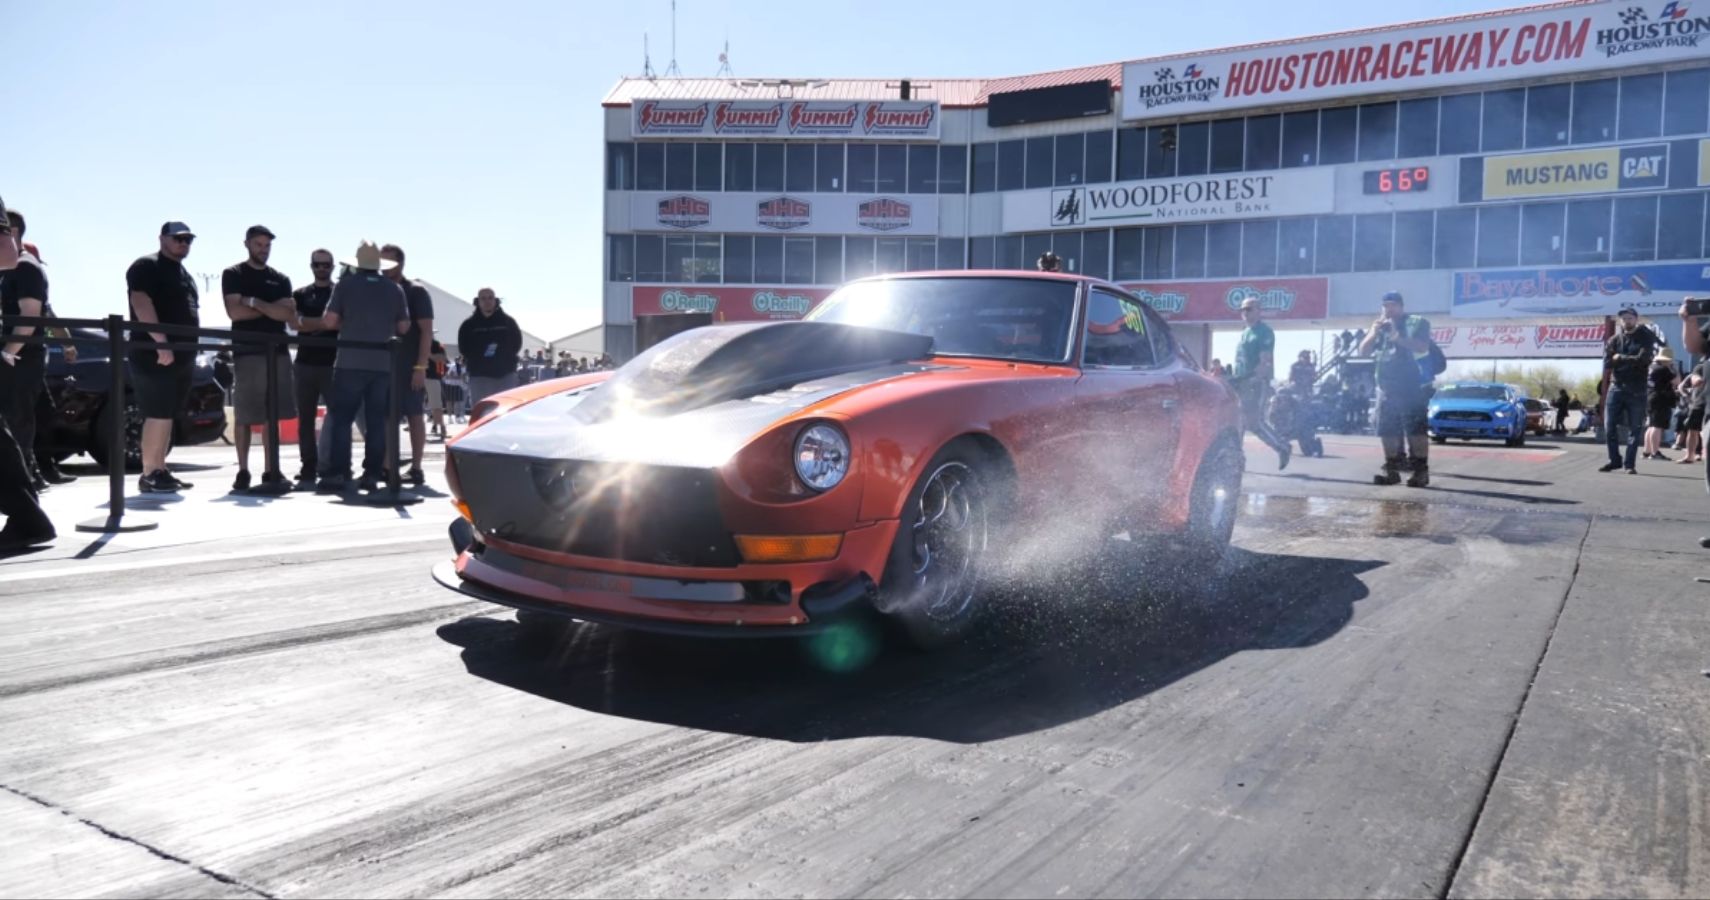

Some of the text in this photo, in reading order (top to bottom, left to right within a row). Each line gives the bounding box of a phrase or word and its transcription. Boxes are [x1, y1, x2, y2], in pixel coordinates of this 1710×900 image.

[1596, 16, 1710, 45] HOUSTON
[1224, 18, 1592, 98] HOUSTONRACEWAY.COM
[1607, 35, 1698, 58] RACEWAY PARK
[1139, 77, 1220, 98] HOUSTON
[1505, 162, 1609, 187] MUSTANG
[1623, 155, 1663, 179] CAT
[1089, 176, 1274, 210] WOODFOREST
[1461, 270, 1624, 308] Bayshore
[661, 290, 717, 313] O'Reilly
[753, 290, 810, 314] O'Reilly
